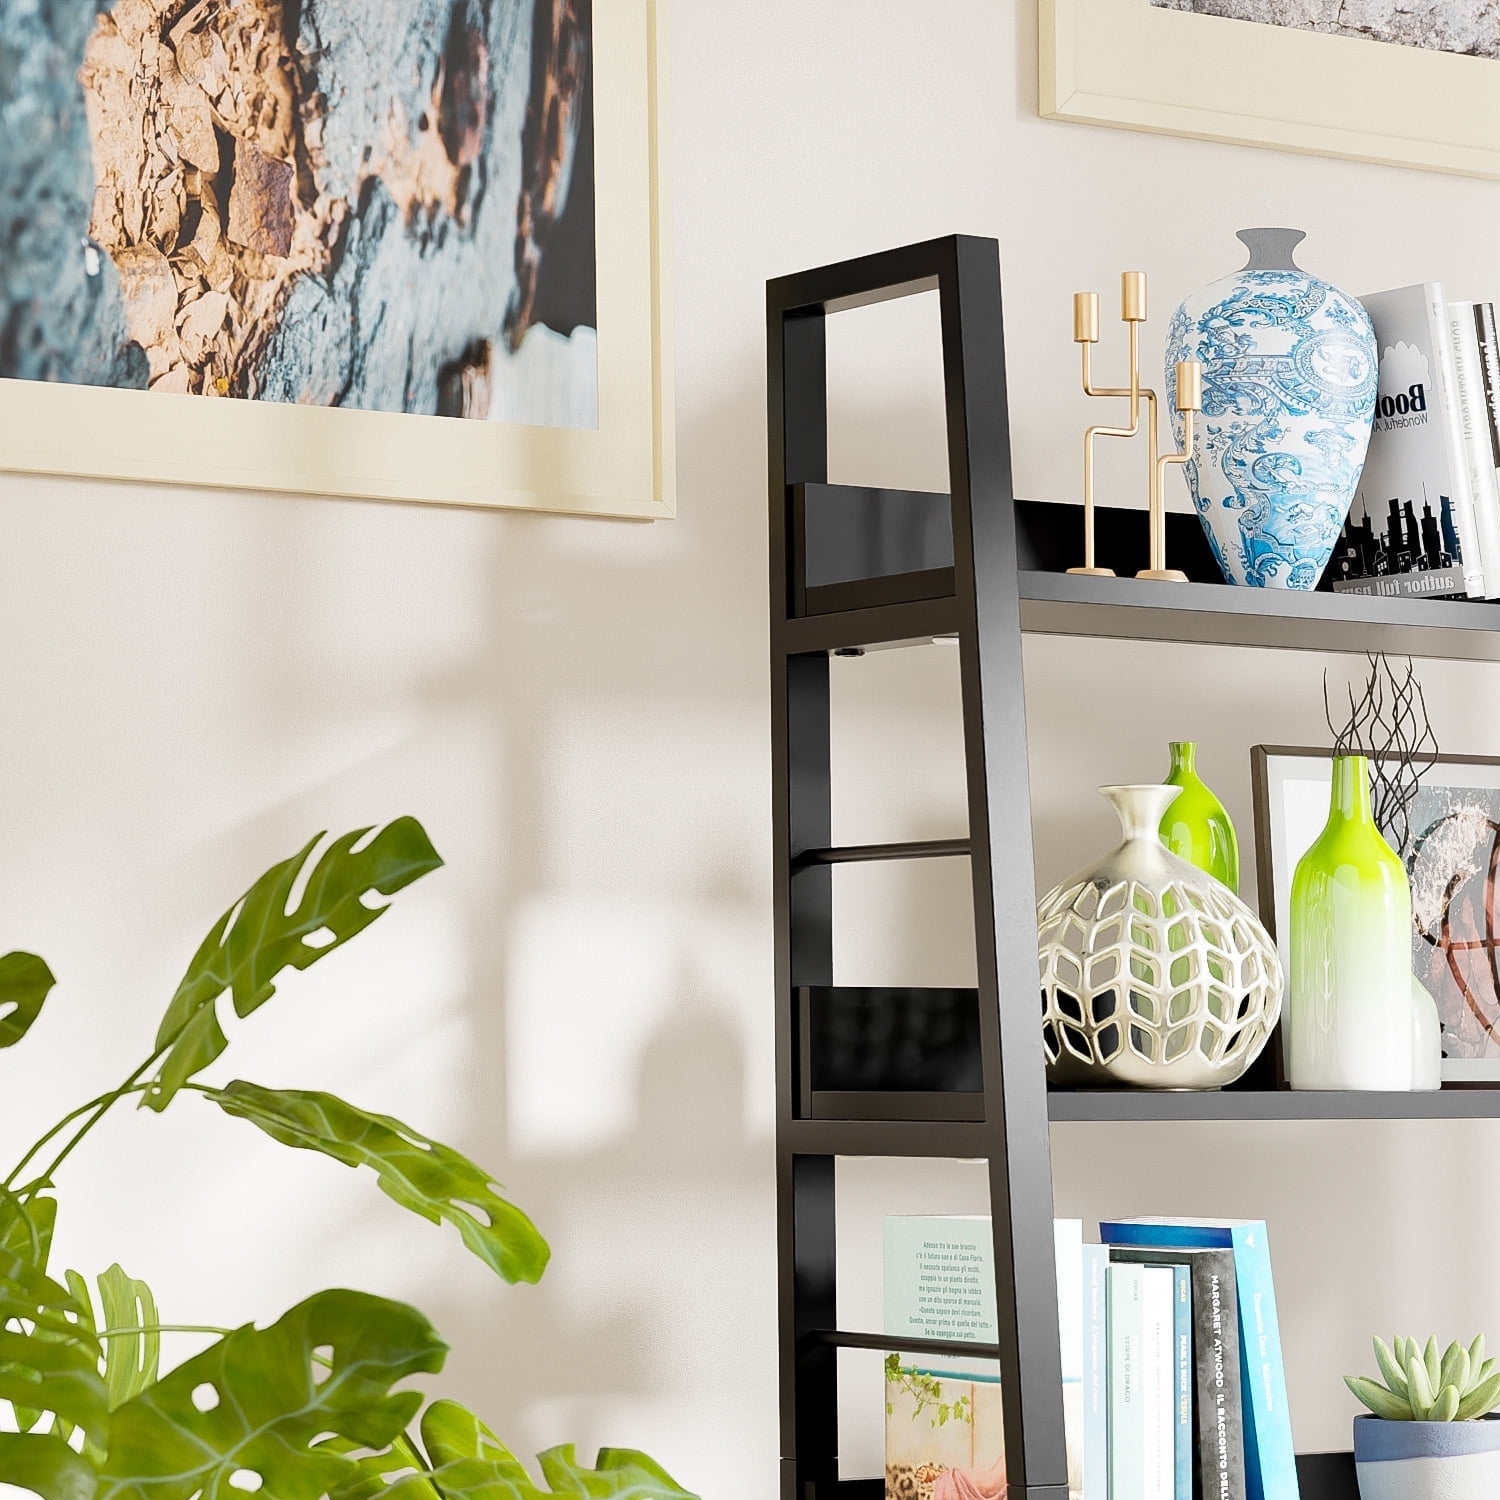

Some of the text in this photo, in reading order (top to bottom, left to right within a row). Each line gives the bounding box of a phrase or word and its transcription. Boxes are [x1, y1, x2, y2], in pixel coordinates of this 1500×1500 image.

[923, 1241, 939, 1249] Adesso
[1210, 1274, 1224, 1388] MARGARET ATWOOD
[1216, 1393, 1225, 1406] IL
[1217, 1408, 1228, 1470] RACCONTO
